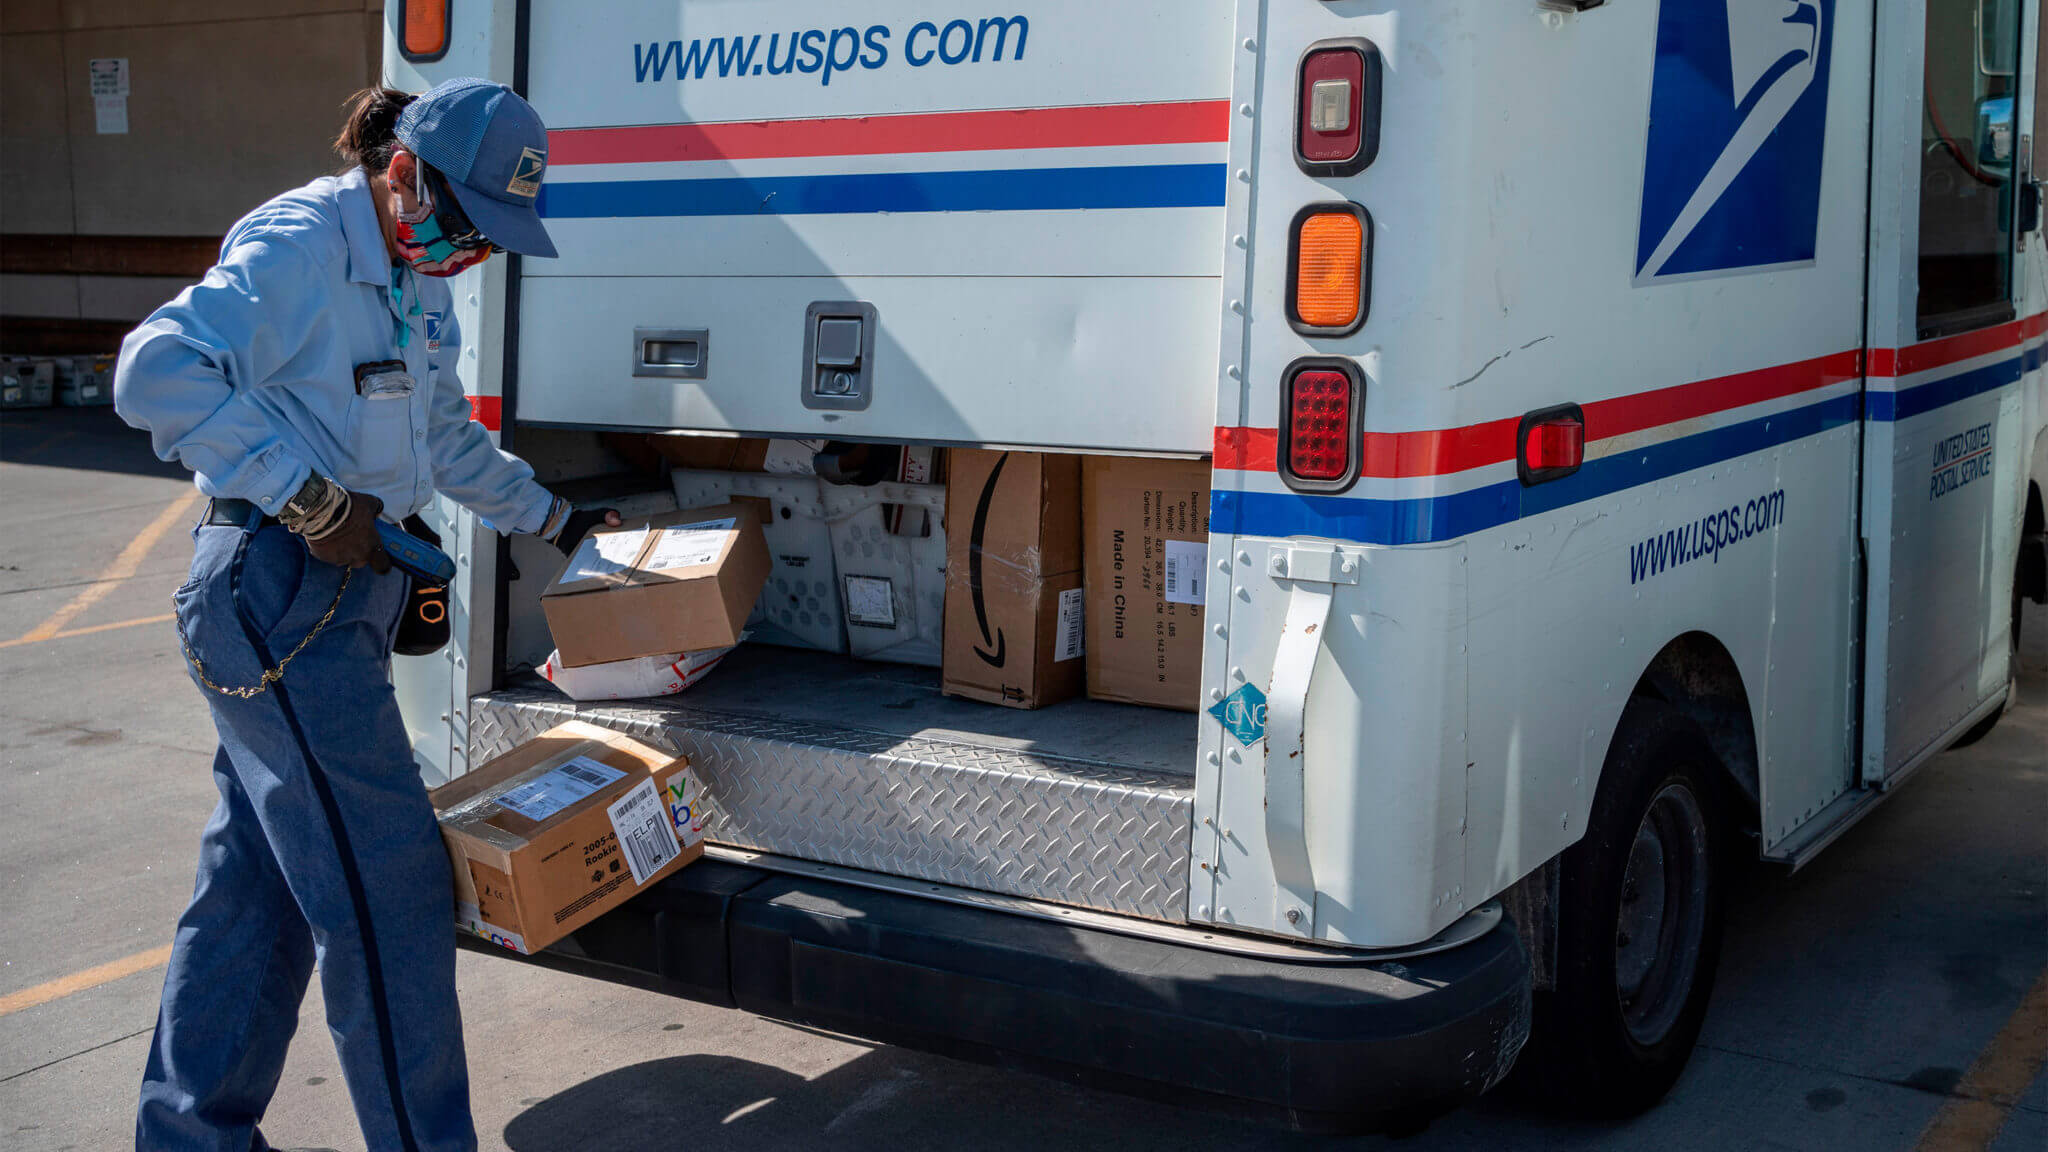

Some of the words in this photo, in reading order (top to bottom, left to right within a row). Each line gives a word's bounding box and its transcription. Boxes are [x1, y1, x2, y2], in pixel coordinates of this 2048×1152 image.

[634, 25, 891, 86] www.usps
[905, 15, 1029, 67] com
[1933, 433, 1963, 467] UNITED
[1964, 422, 1991, 454] STATES
[1930, 466, 1958, 501] POSTAL
[1961, 451, 1991, 486] SERVICE
[1113, 529, 1125, 571] Made
[1630, 489, 1784, 585] www.usps.com
[1114, 576, 1125, 590] in
[1114, 594, 1126, 639] China
[632, 818, 654, 840] ELP
[584, 844, 617, 867] Rookie
